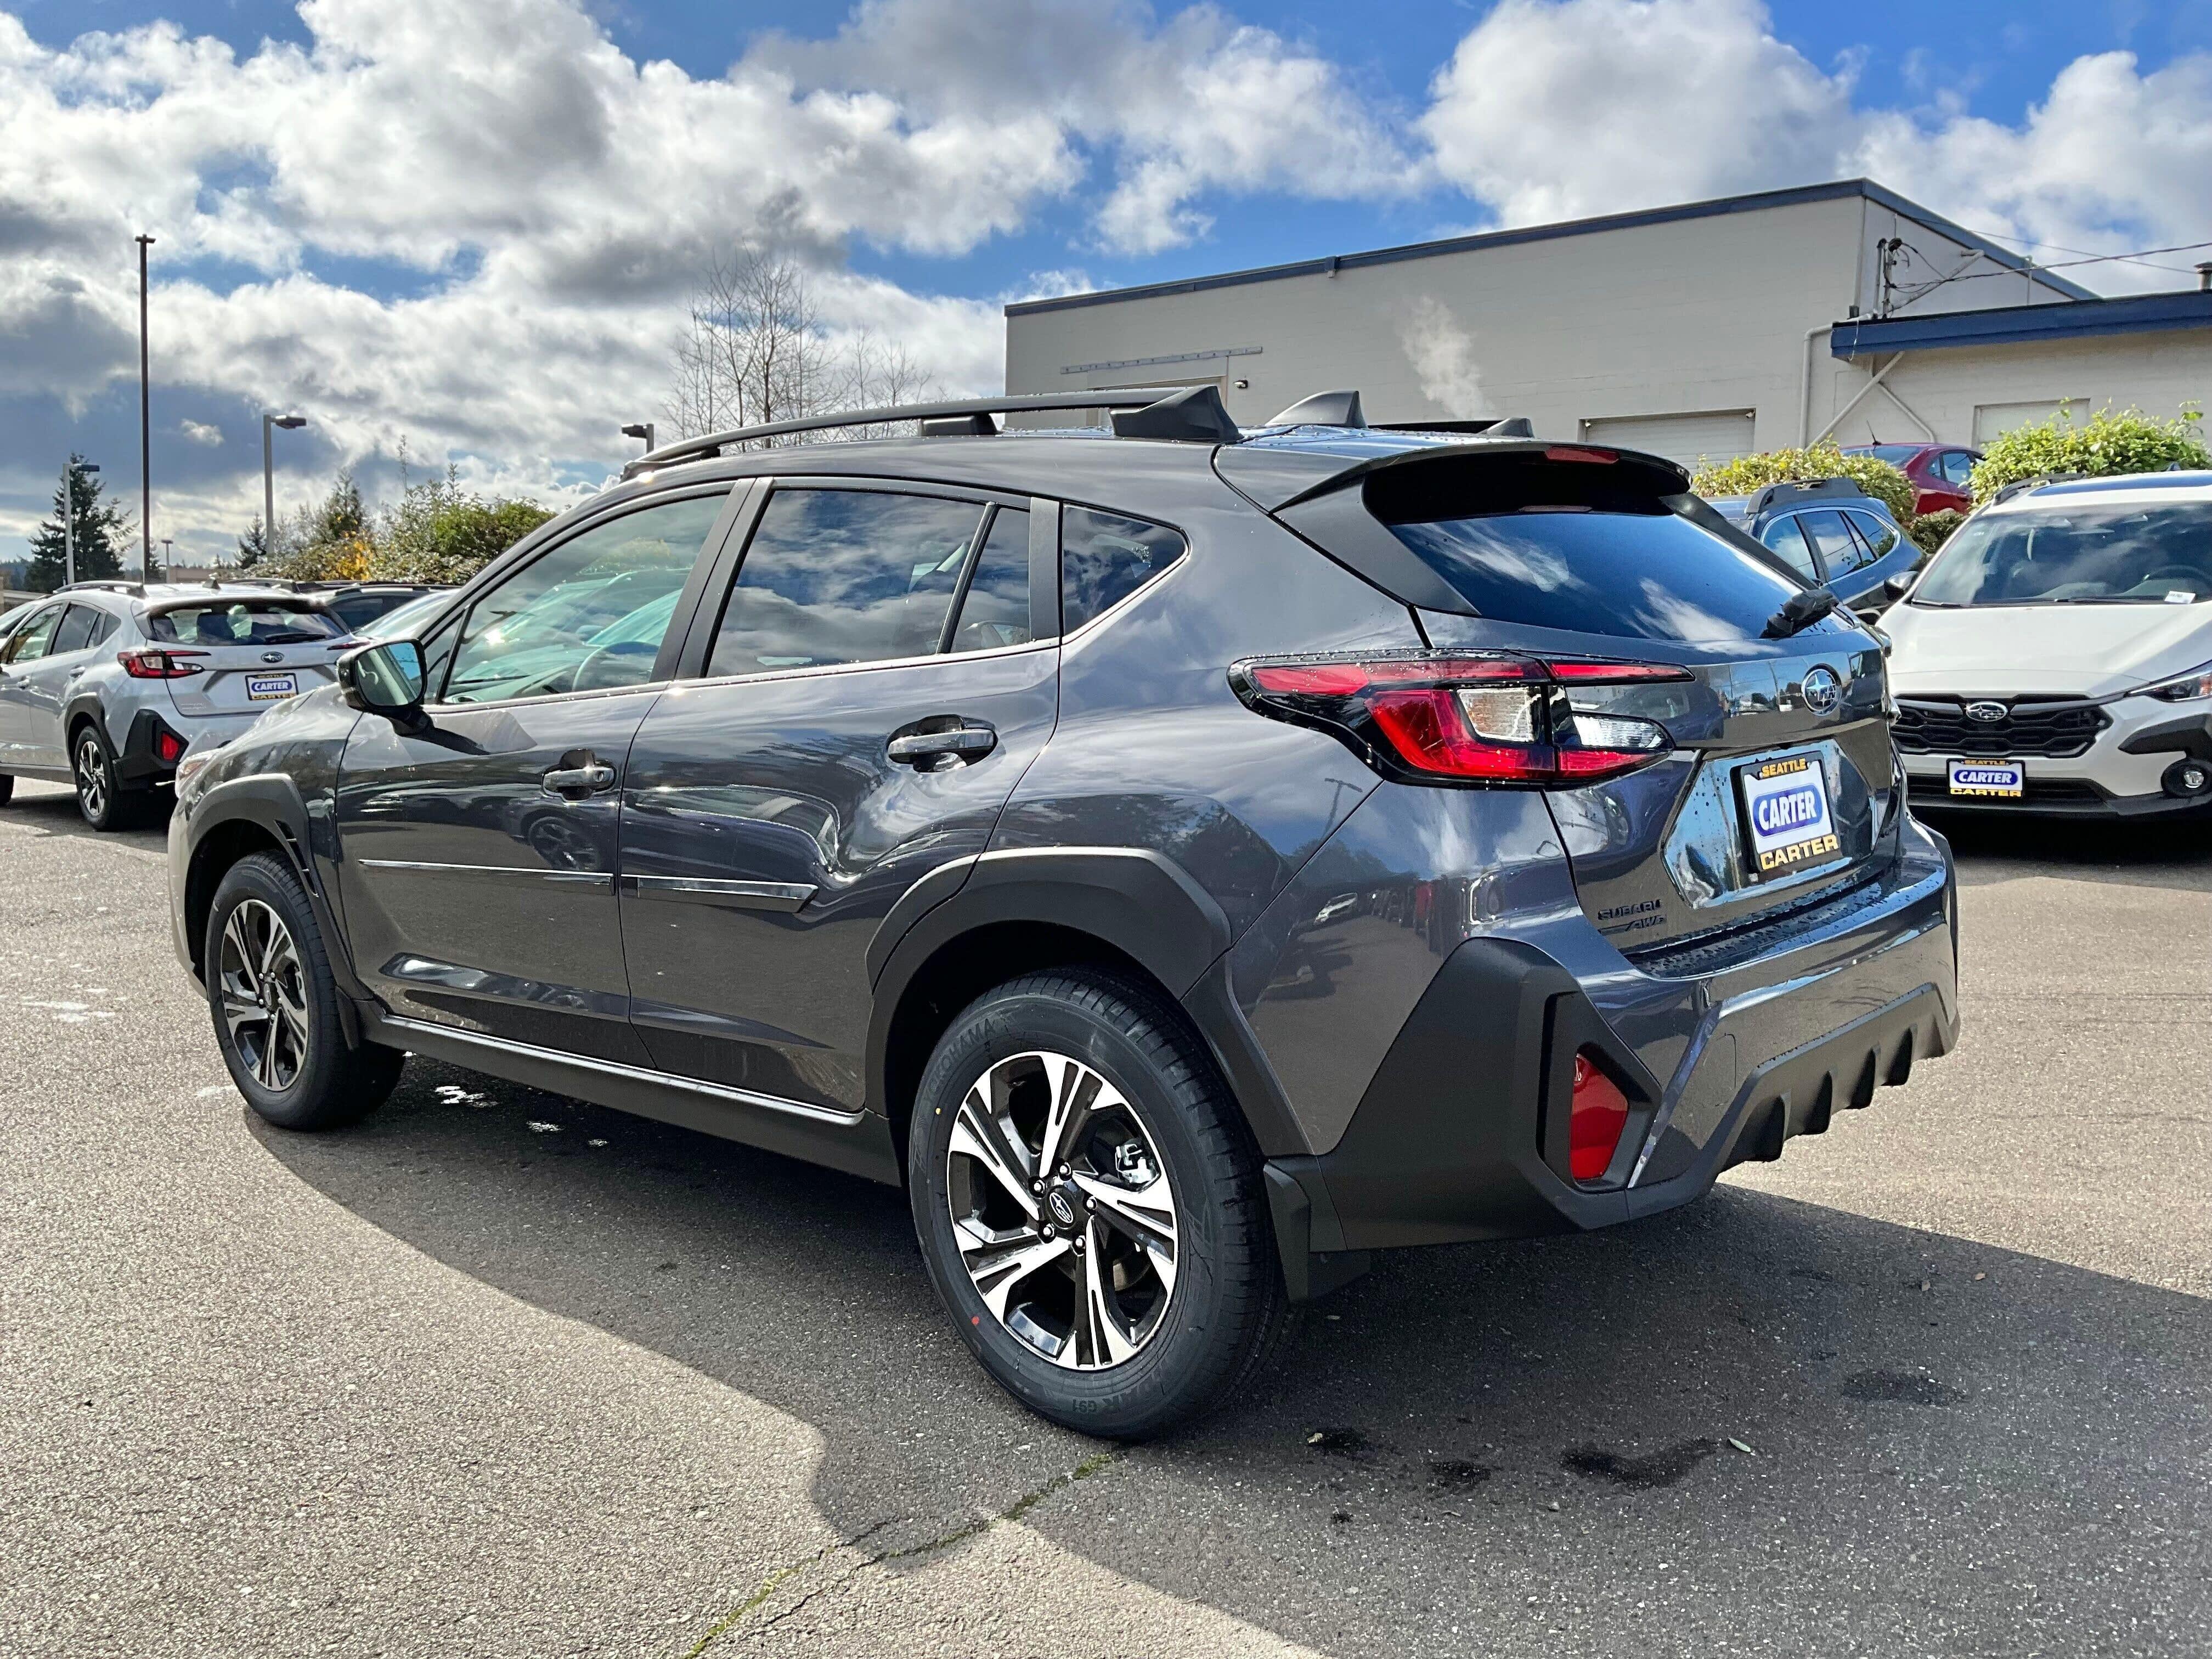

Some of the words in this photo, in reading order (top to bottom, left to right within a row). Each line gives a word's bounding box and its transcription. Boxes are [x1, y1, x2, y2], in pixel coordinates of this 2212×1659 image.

[255, 682, 289, 691] CARTER
[1762, 758, 1807, 778] SEATTLE
[1959, 771, 2012, 783] CARTER
[1950, 788, 2022, 797] CARTER
[1758, 790, 1817, 831] CARTER
[1760, 834, 1838, 870] CARTER
